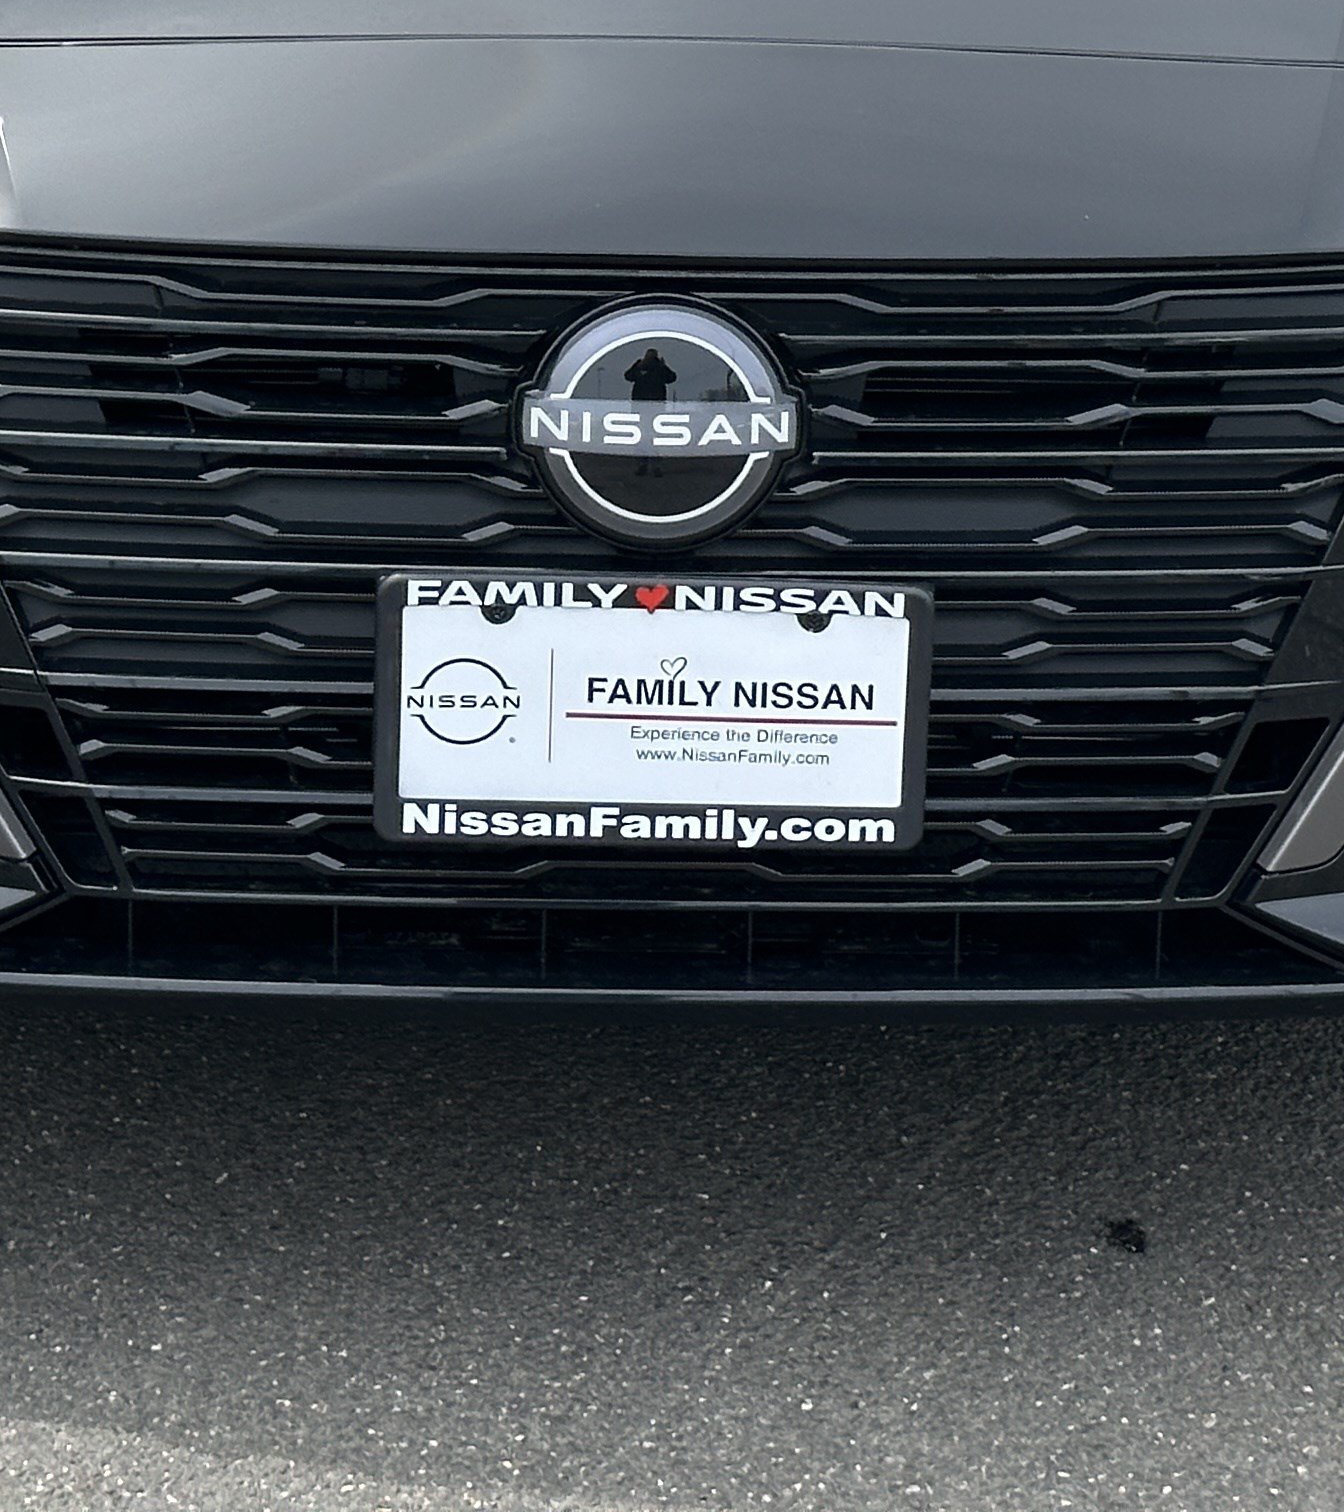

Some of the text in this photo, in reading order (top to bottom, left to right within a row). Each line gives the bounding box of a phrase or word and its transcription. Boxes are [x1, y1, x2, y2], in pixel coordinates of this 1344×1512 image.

[529, 406, 790, 447] NISSAN
[407, 579, 906, 619] FAMILY NISSAN
[406, 694, 521, 709] NISSAN
[587, 676, 874, 711] FAMILY NISSAN
[630, 725, 839, 745] Experience the Difference
[636, 747, 831, 766] www.NissanFamily.com
[401, 802, 896, 849] NissanFamily.com
